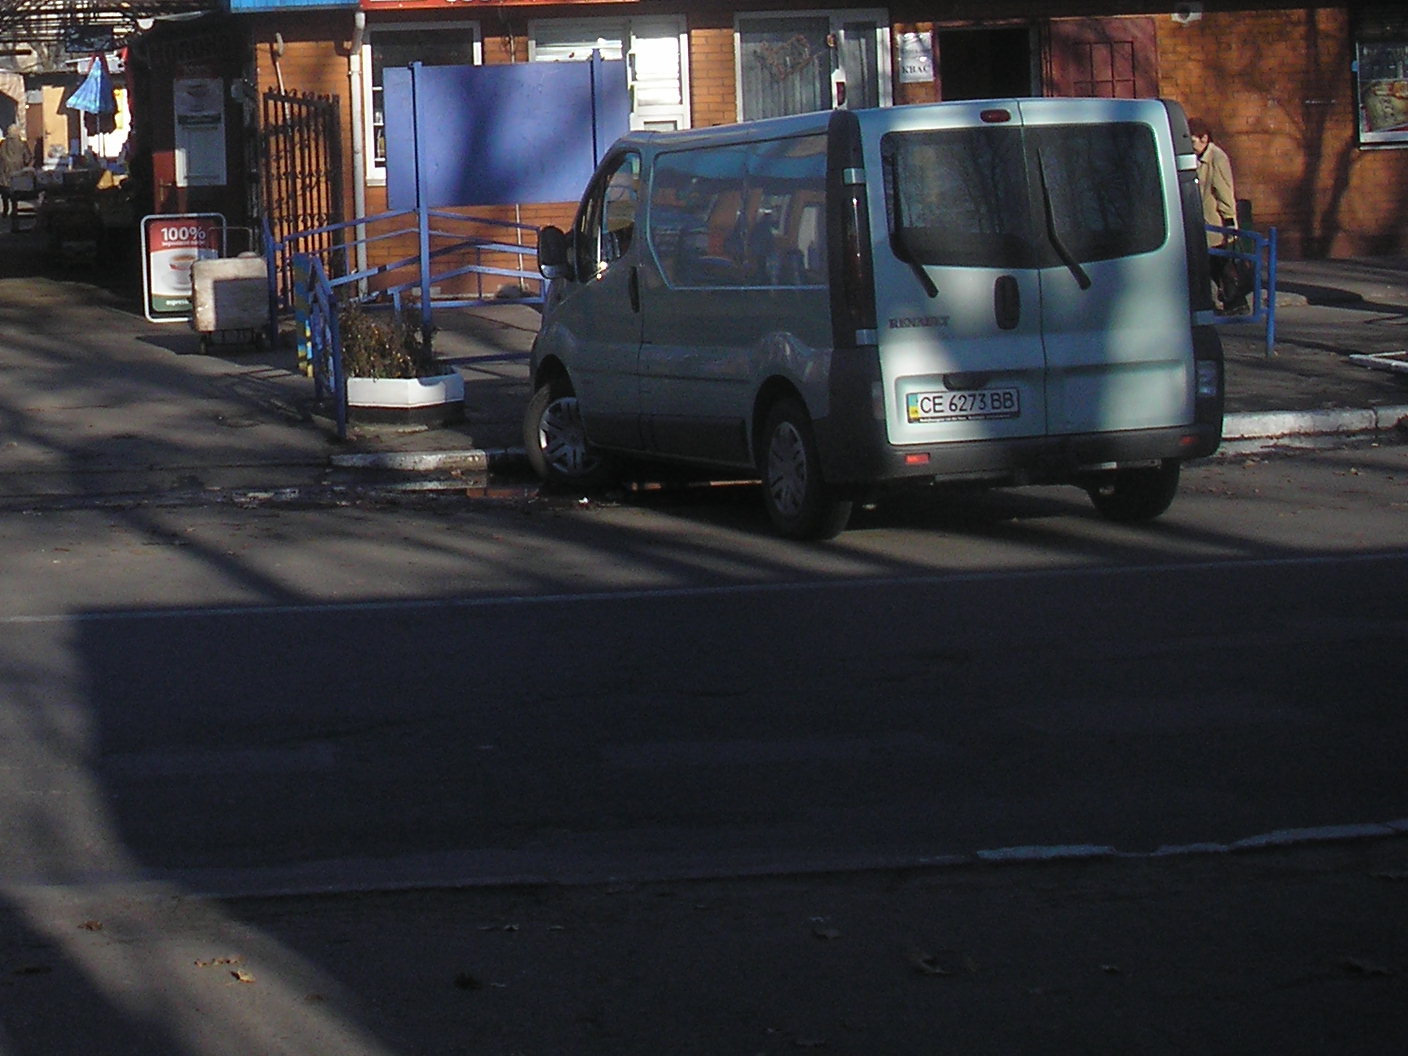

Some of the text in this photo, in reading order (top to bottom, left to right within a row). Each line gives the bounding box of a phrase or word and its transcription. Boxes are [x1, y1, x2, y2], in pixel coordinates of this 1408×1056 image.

[160, 226, 206, 241] 100%
[920, 391, 1014, 414] CE 6273 BB
